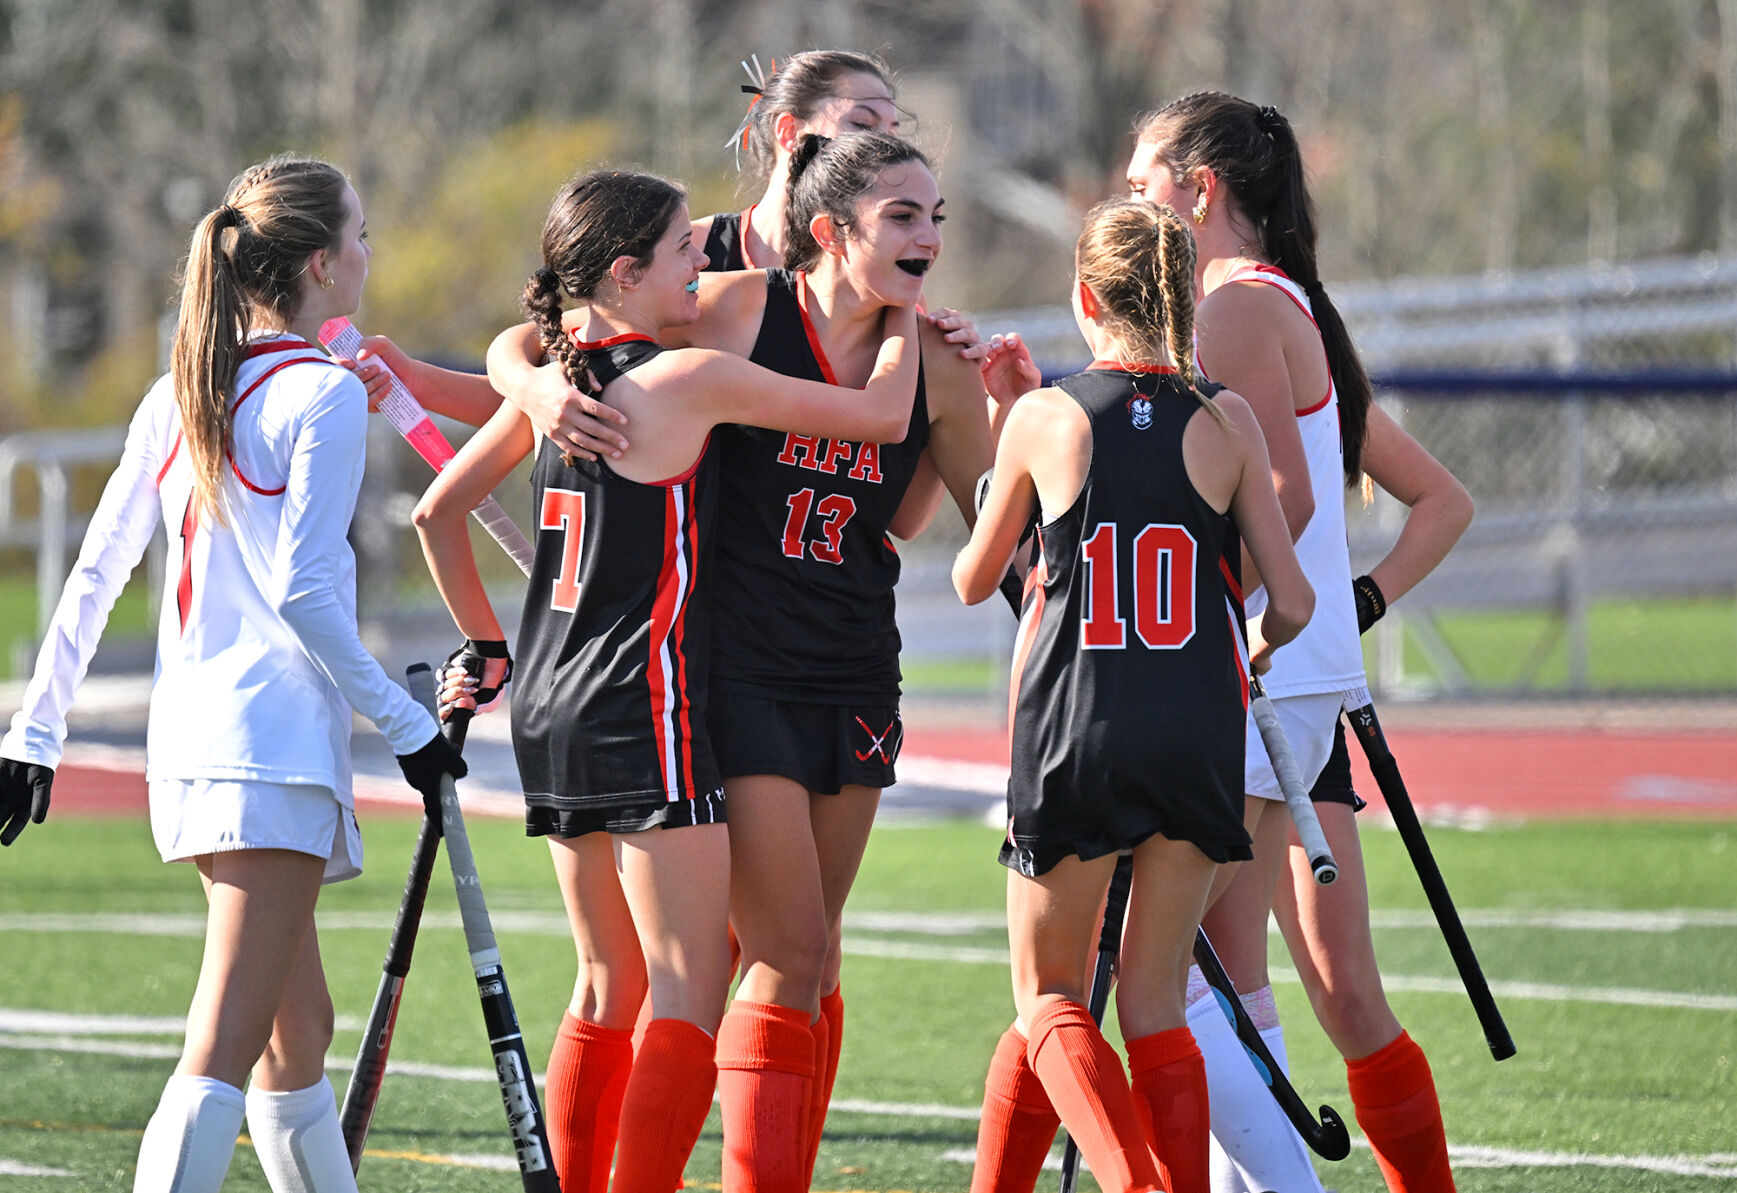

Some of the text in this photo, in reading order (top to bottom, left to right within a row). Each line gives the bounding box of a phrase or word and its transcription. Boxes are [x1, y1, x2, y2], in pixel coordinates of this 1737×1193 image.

[777, 432, 884, 484] RFA
[540, 487, 586, 613] 7
[781, 487, 857, 566] 13
[1081, 521, 1198, 651] 10
